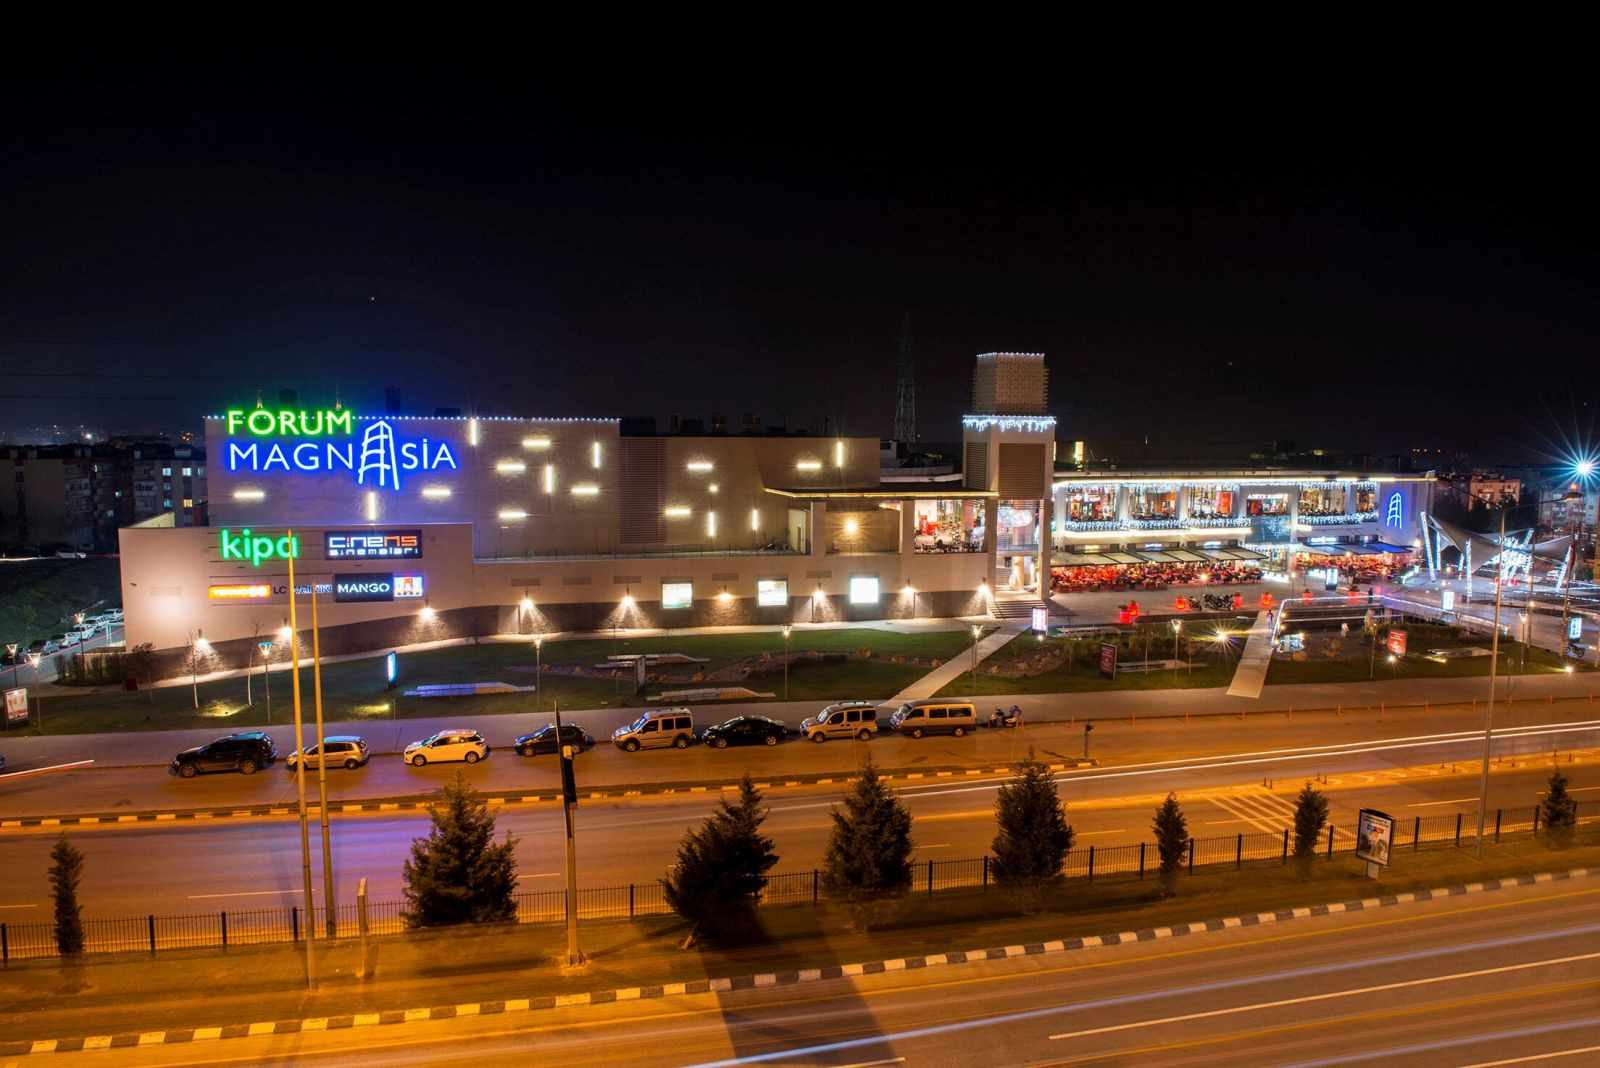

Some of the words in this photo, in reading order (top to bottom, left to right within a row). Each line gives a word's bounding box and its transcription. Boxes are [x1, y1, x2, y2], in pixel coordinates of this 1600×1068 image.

[228, 410, 351, 435] FORUM
[222, 528, 298, 566] kipa
[273, 586, 287, 595] LC
[337, 583, 390, 593] MANGO
